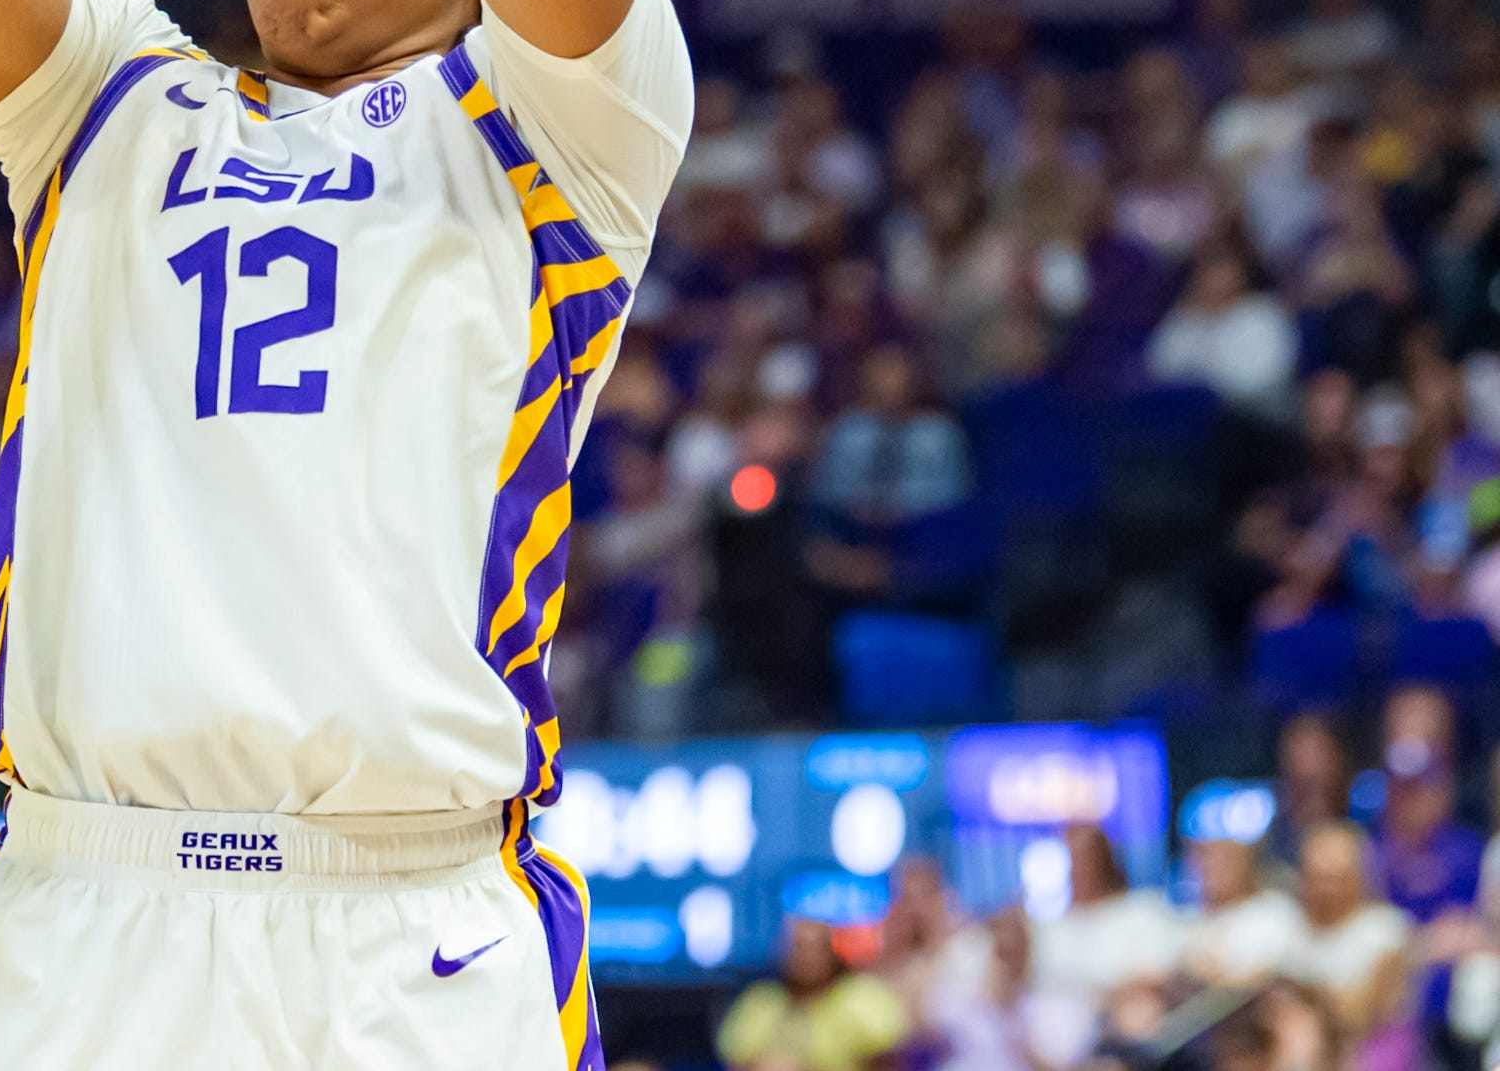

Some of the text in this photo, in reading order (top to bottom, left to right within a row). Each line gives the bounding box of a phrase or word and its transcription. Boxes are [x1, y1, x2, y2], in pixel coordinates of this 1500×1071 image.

[366, 86, 401, 122] SEC
[161, 148, 374, 213] LSU
[167, 226, 338, 419] 12
[182, 831, 278, 851] GEAUX
[176, 853, 283, 872] TIGERS
